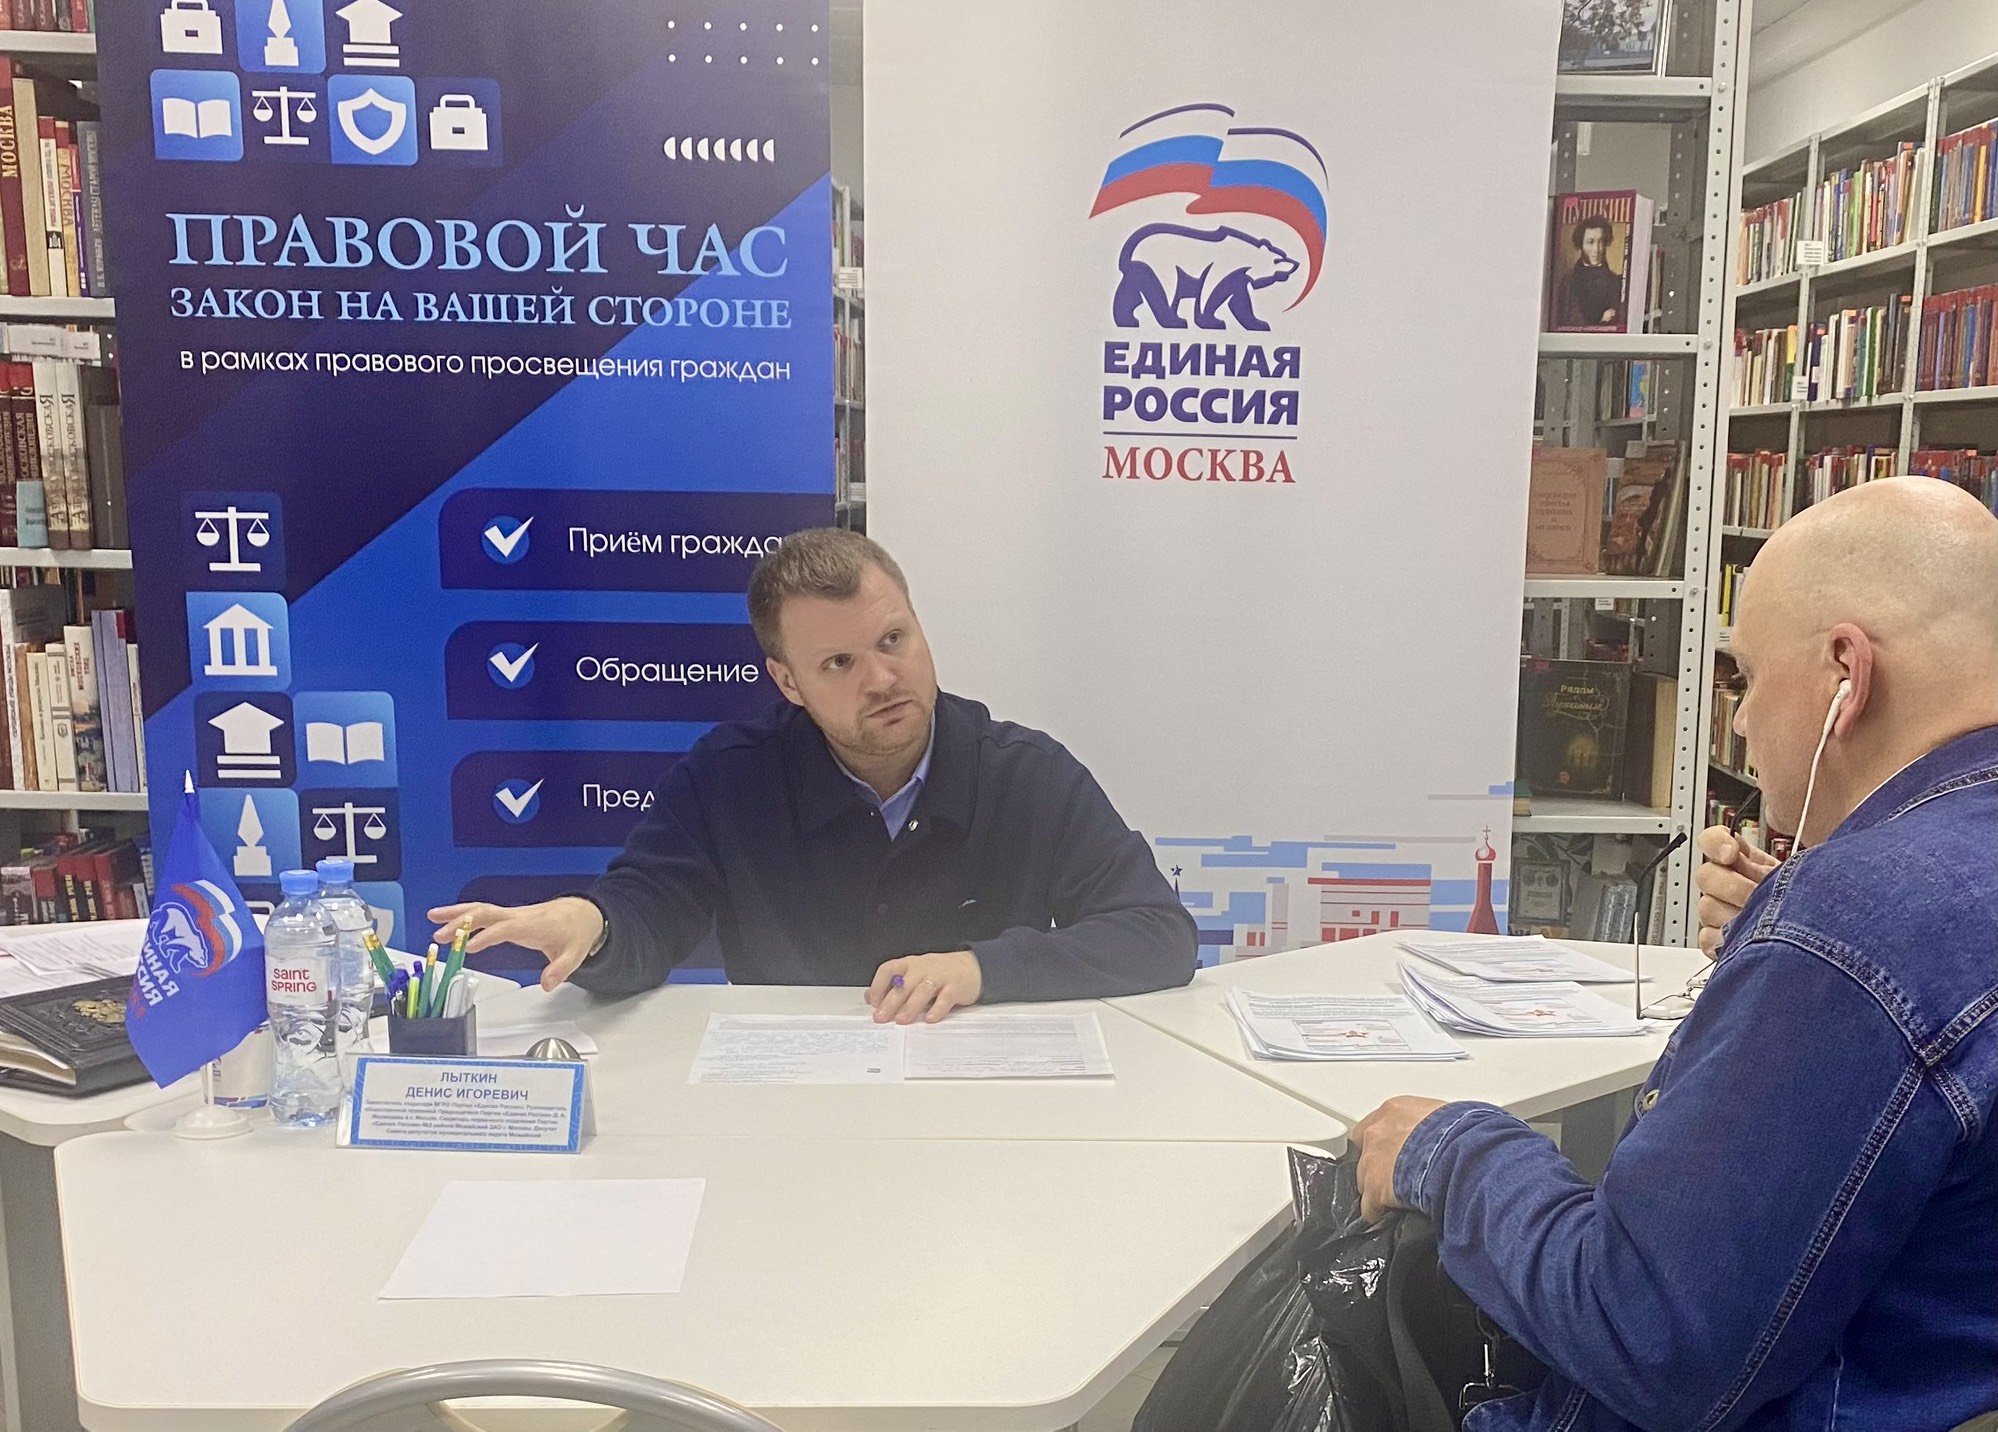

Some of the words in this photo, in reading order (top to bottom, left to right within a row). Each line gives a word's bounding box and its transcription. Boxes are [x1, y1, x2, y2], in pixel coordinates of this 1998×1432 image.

[0, 105, 18, 178] МОСКВА
[59, 164, 75, 226] МОСКВА
[165, 203, 609, 275] ПРАВОВОЙ
[627, 222, 789, 278] ЧАС
[170, 287, 324, 320] ЗАКОН
[336, 290, 404, 321] НА
[413, 286, 576, 325] ВАШЕЙ
[588, 295, 792, 329] СТОРОНЕ
[180, 350, 194, 370] в
[201, 350, 309, 375] рамках
[316, 352, 464, 377] правового
[471, 355, 663, 380] просвещения
[670, 359, 791, 383] граждан
[1103, 341, 1301, 380] ЕДИНАЯ
[1103, 385, 1299, 426] РОССИЯ
[16, 412, 29, 480] ОСКОВСКАЯ
[1102, 446, 1296, 484] МОСКВА
[568, 527, 662, 558] Приём
[671, 534, 783, 559] гражда
[576, 656, 759, 687] Обращение
[582, 783, 655, 812] Пред
[137, 965, 163, 1007] СИЯ
[143, 940, 180, 997] ИНАЯ
[405, 1086, 453, 1099] ДЕНИС
[456, 1088, 529, 1101] ИГОРЕВИЧ
[440, 1072, 498, 1084] ЛЫТКИН
